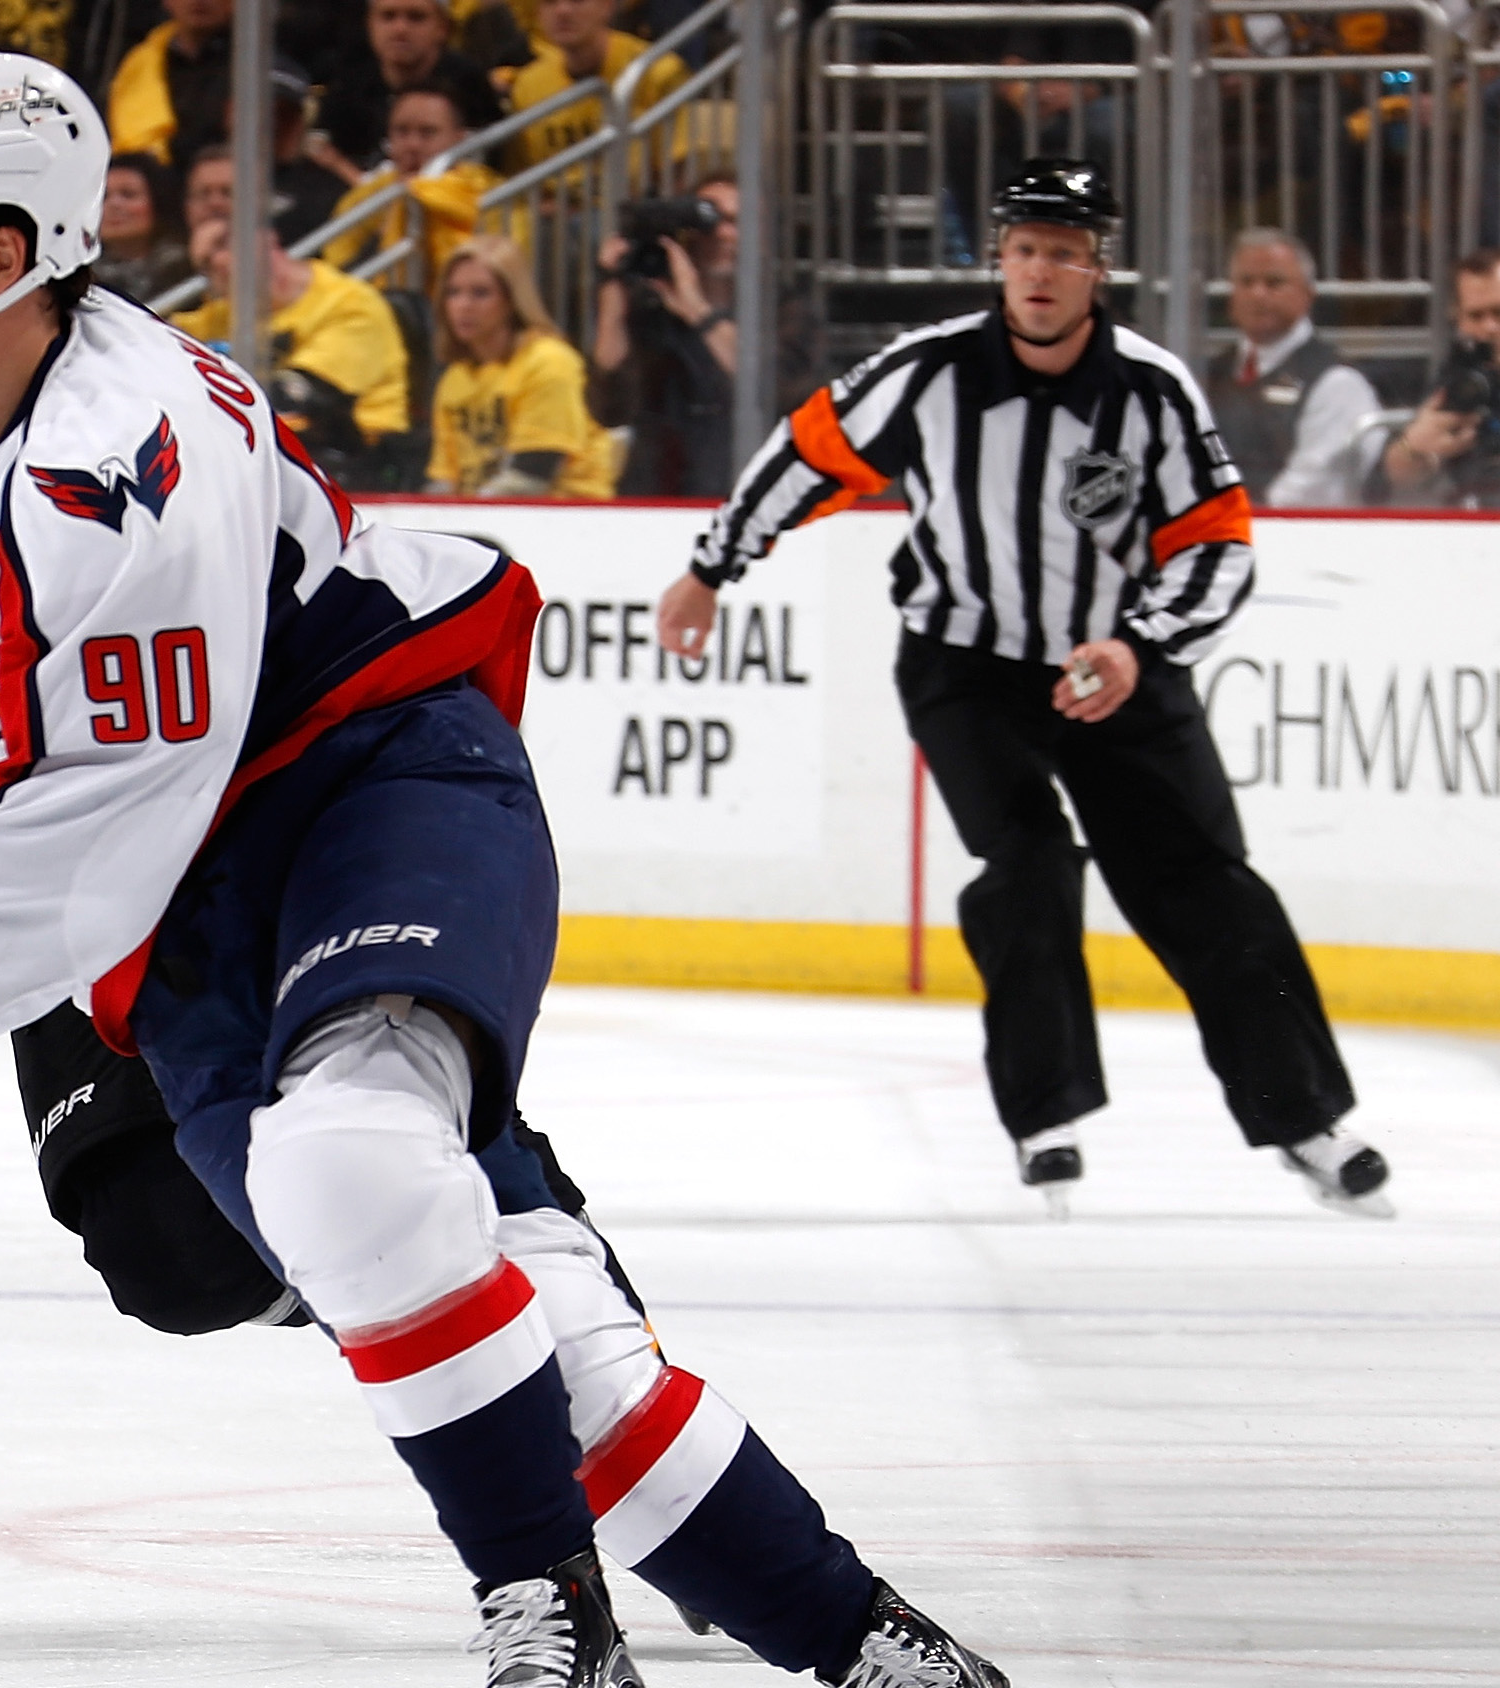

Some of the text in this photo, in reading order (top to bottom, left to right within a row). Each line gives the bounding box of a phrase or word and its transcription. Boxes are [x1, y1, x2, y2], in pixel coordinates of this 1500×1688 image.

[82, 627, 210, 745] 90
[1203, 656, 1500, 797] GHMAR
[613, 716, 735, 796] APP
